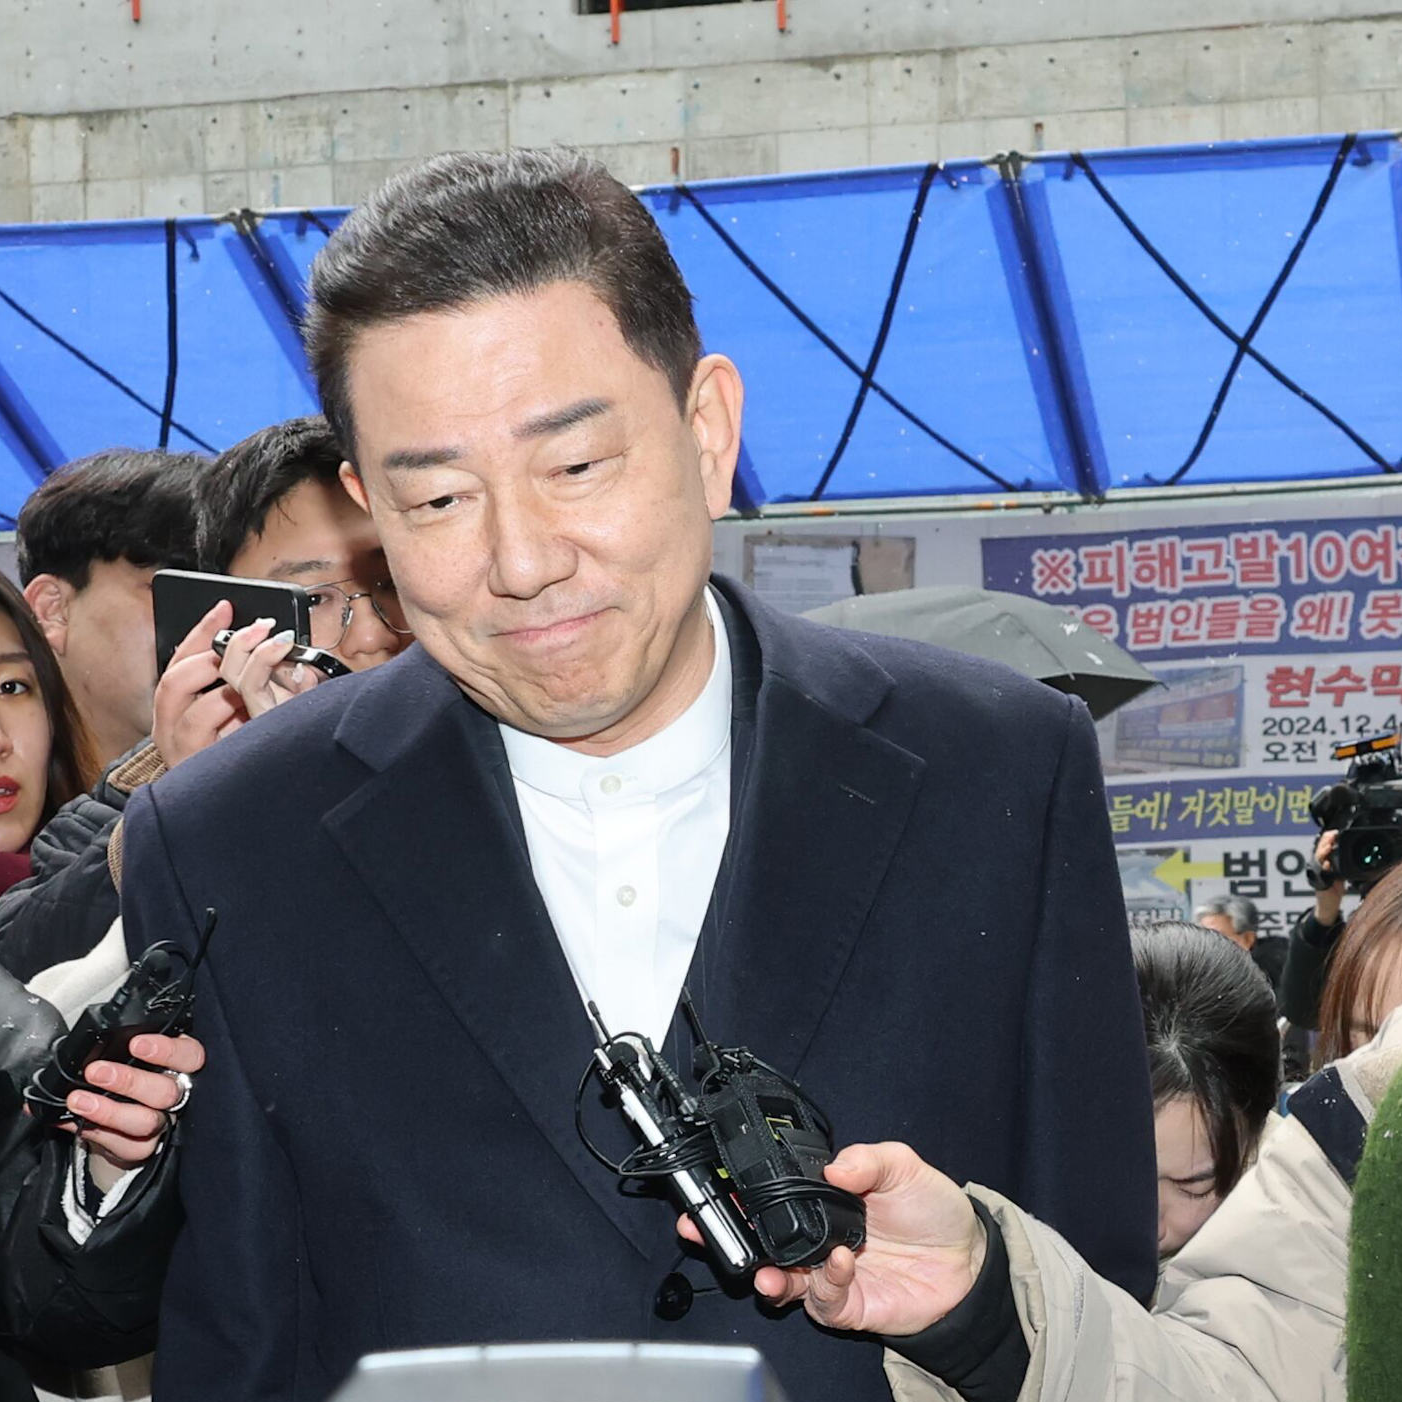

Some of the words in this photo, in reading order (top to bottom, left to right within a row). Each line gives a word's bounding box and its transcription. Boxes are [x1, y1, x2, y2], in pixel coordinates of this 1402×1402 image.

[1131, 597, 1282, 646] 범인들을
[1295, 596, 1349, 636] 왜!
[1262, 740, 1318, 764] 오전
